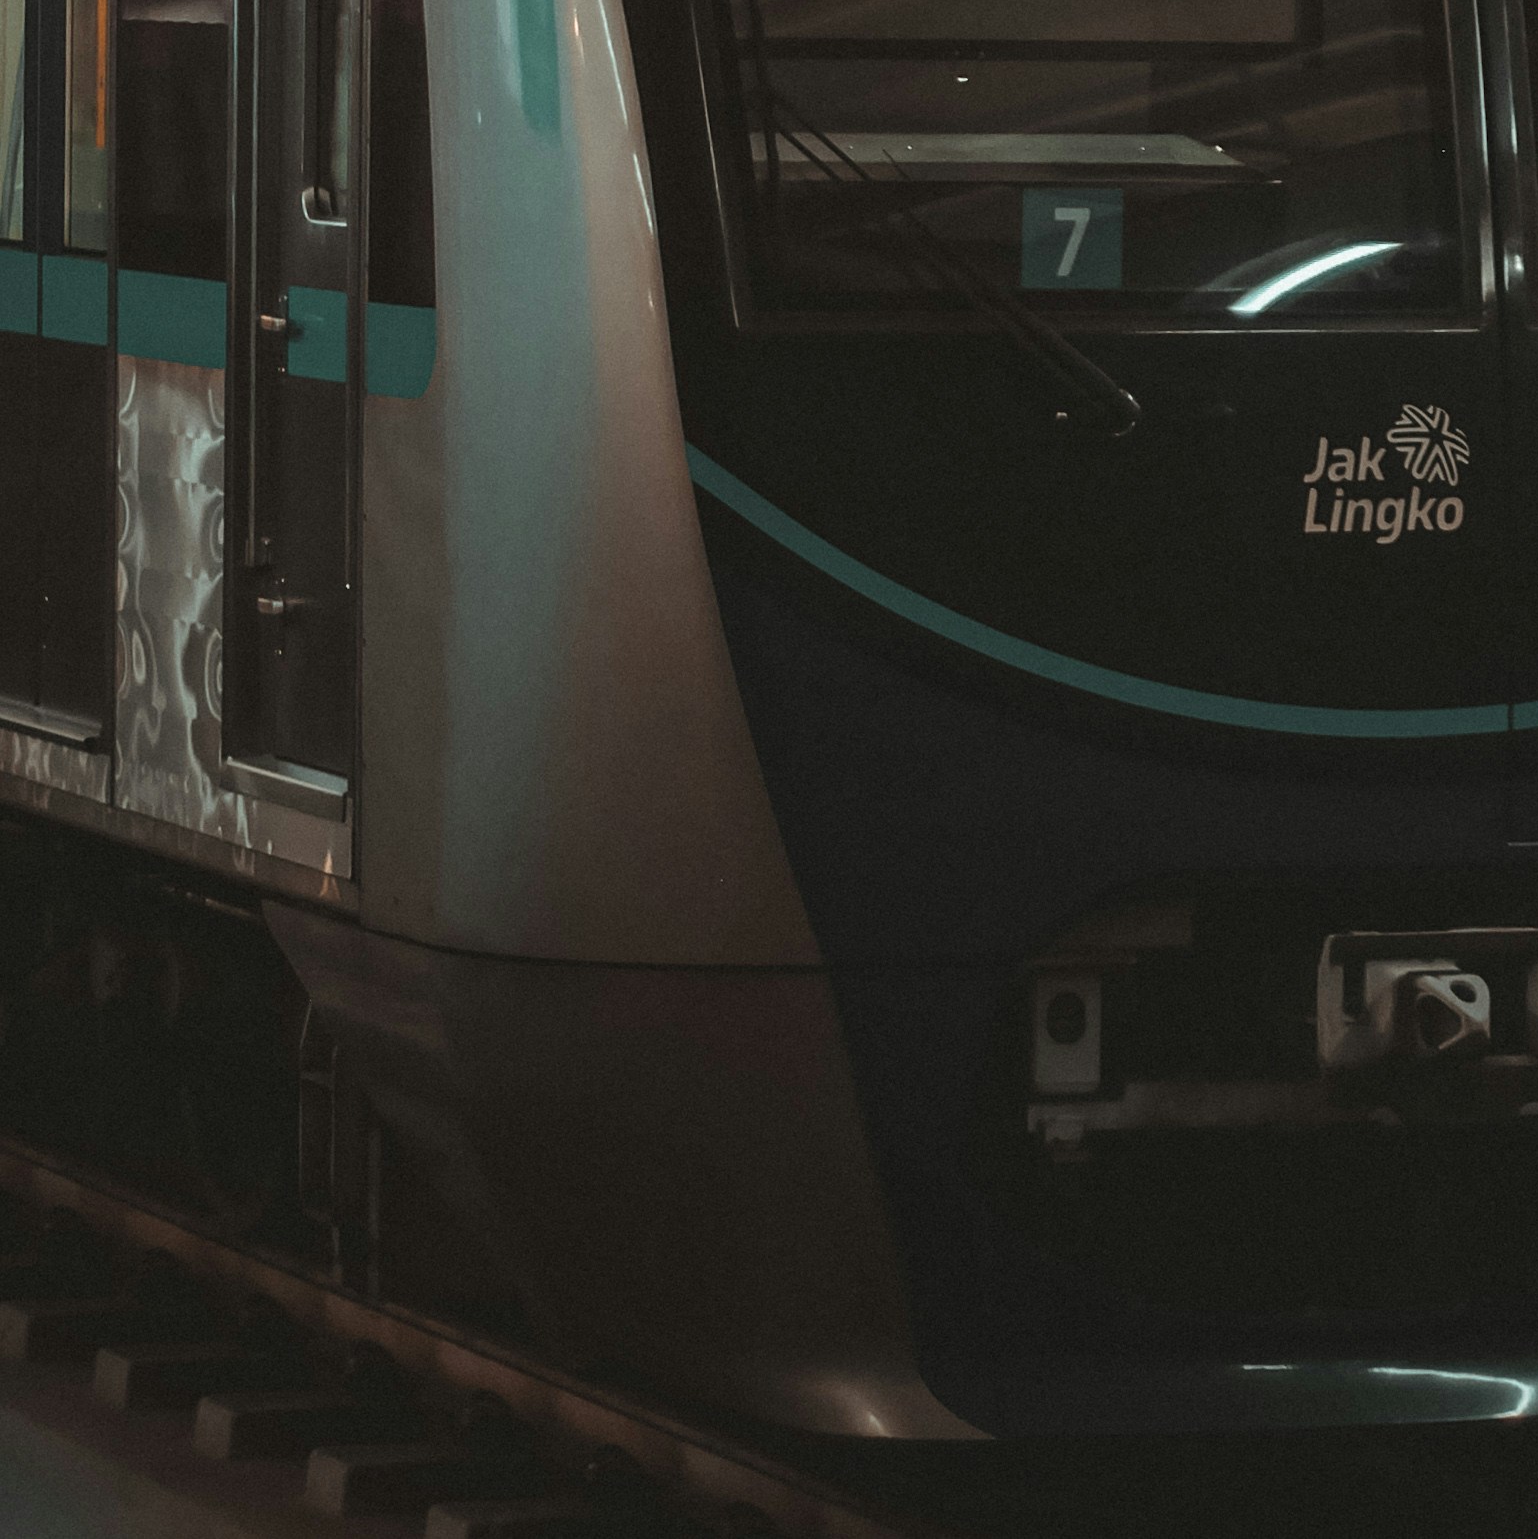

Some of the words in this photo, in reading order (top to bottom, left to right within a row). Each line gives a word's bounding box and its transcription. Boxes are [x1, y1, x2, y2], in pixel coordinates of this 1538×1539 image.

[1054, 207, 1091, 277] 7
[1303, 437, 1386, 483] Jak
[1303, 486, 1463, 544] Lingko
